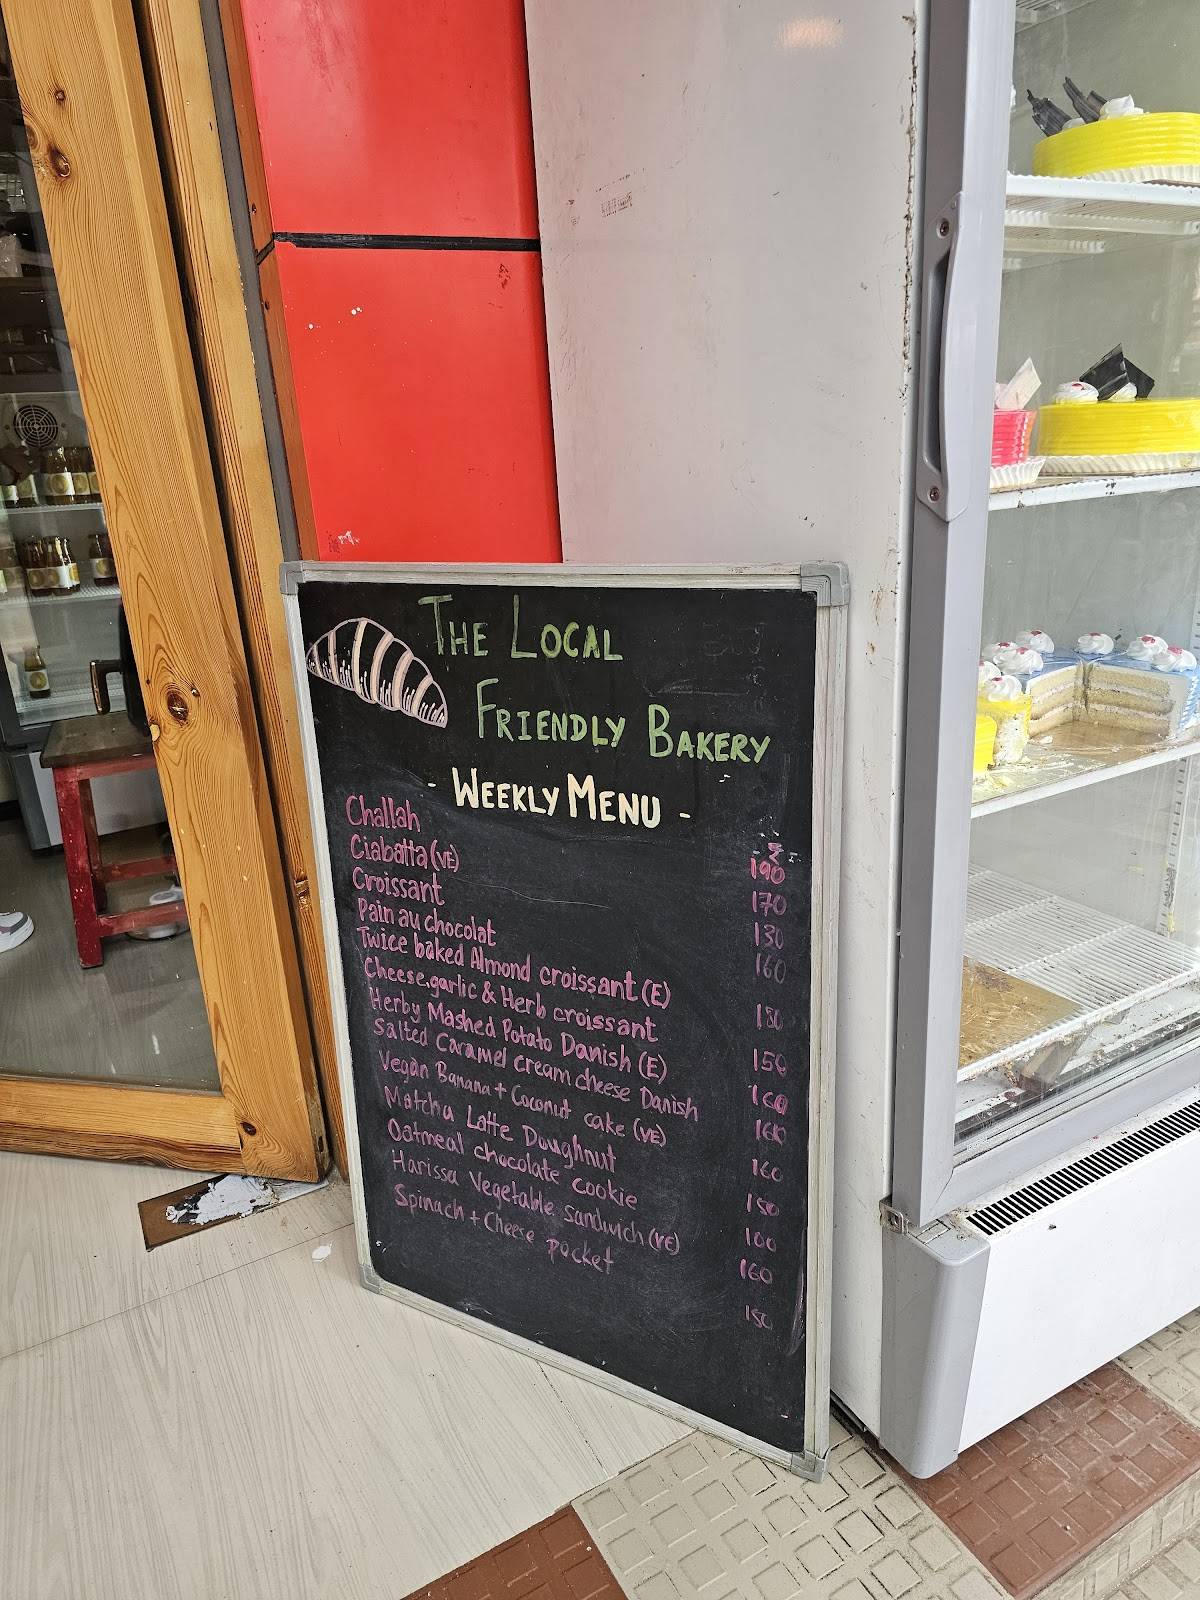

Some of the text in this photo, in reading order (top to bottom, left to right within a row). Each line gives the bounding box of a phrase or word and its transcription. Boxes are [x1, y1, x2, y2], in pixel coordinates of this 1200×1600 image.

[418, 594, 624, 661] THE LOCAL
[476, 678, 771, 764] FRIENDLY BAKERY
[345, 795, 421, 833] Challah
[451, 766, 560, 817] WEEKLY
[567, 773, 662, 829] MENU
[352, 866, 445, 906] Croissant
[750, 857, 786, 885] 190
[357, 897, 497, 947] Pain au chocolat
[752, 890, 788, 917] 170
[356, 926, 409, 954] Twice
[413, 932, 465, 967] baked
[470, 946, 532, 984] Almond
[539, 966, 639, 1001] croissant
[754, 921, 785, 950] 130
[756, 953, 787, 984] 160
[369, 986, 421, 1024] Herby
[427, 1001, 496, 1039] Mashed
[502, 1017, 553, 1052] Potato
[560, 1031, 632, 1073] Danish
[481, 980, 497, 1006] &
[500, 984, 547, 1020] Herb
[553, 1007, 659, 1043] croissant
[378, 1049, 429, 1084] Vegan
[435, 1060, 492, 1097] Banana
[583, 1111, 625, 1138] cake
[435, 1031, 507, 1069] Caramel
[513, 1053, 571, 1086] cream
[574, 1067, 631, 1102] cheese
[639, 1086, 699, 1122] Danish
[753, 1048, 787, 1078] 150
[384, 1085, 617, 1173] Matcha Latte Doughnut
[755, 1118, 788, 1147] 160
[387, 1117, 639, 1211] Oatmeal chocolate cookie
[391, 1149, 460, 1187] Harissa
[468, 1169, 556, 1218] Vegetable
[751, 1158, 784, 1183] 160
[393, 1183, 466, 1223] Spinach
[483, 1210, 536, 1244] Cheese
[739, 1257, 774, 1285] 160
